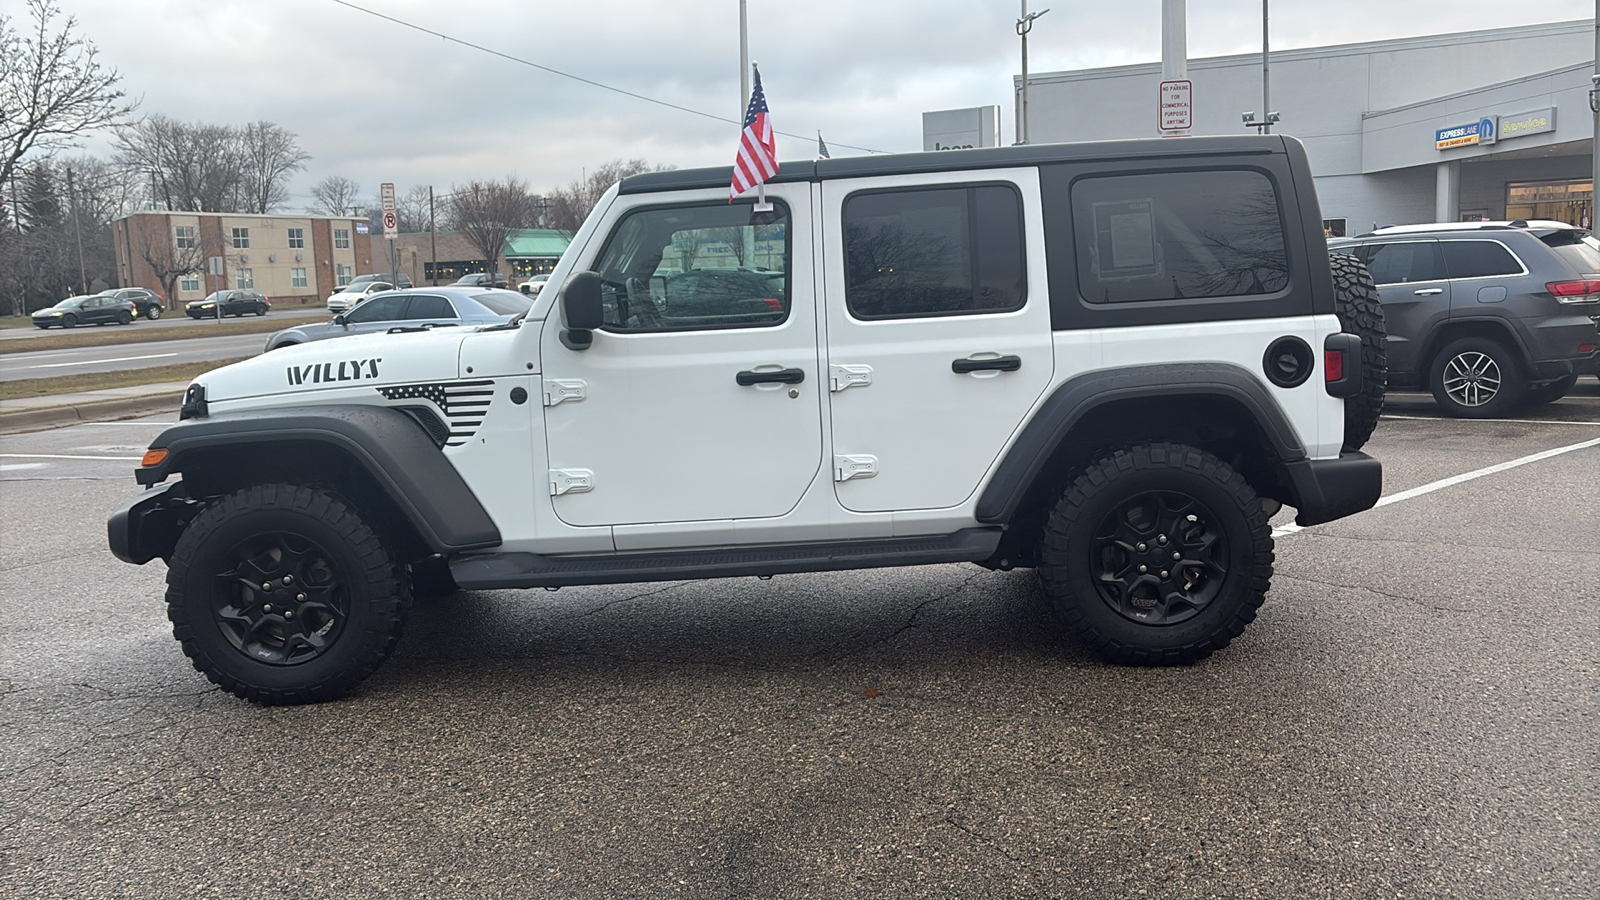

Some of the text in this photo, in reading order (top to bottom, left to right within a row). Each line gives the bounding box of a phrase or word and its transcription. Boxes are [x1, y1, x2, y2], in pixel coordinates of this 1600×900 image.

[1502, 117, 1547, 135] Service
[707, 246, 729, 254] FREE
[286, 357, 383, 386] WILLYS
